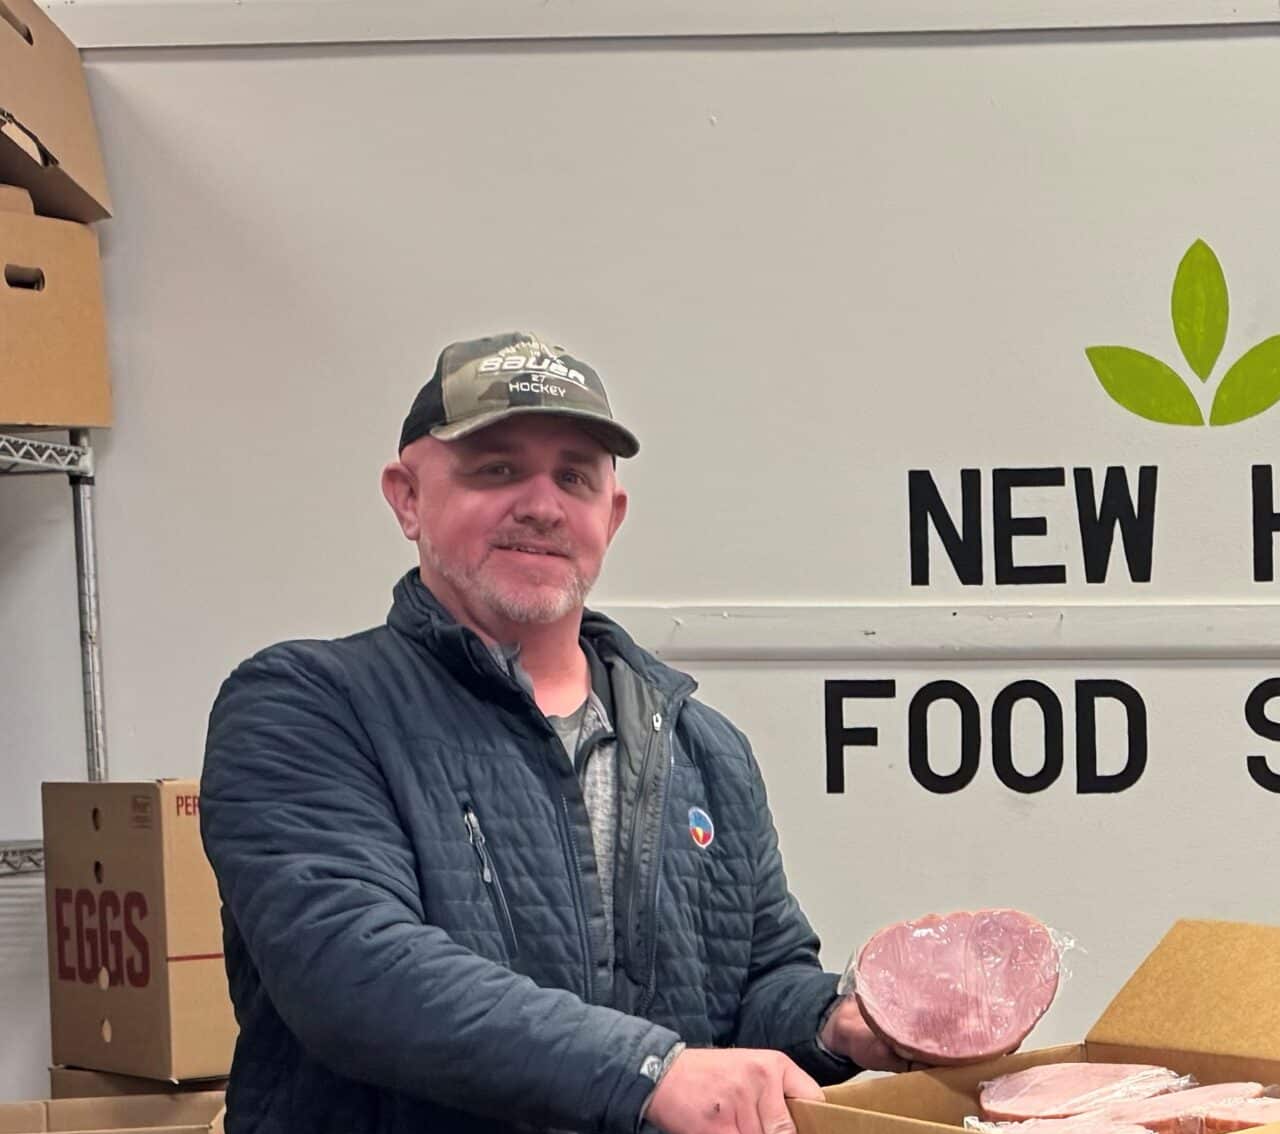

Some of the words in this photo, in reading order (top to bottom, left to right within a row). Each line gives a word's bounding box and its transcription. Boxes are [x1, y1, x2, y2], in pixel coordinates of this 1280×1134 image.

[509, 382, 566, 397] HOCKEY
[908, 465, 1158, 586] NEW
[824, 678, 1148, 795] FOOD
[55, 888, 150, 988] EGGS
